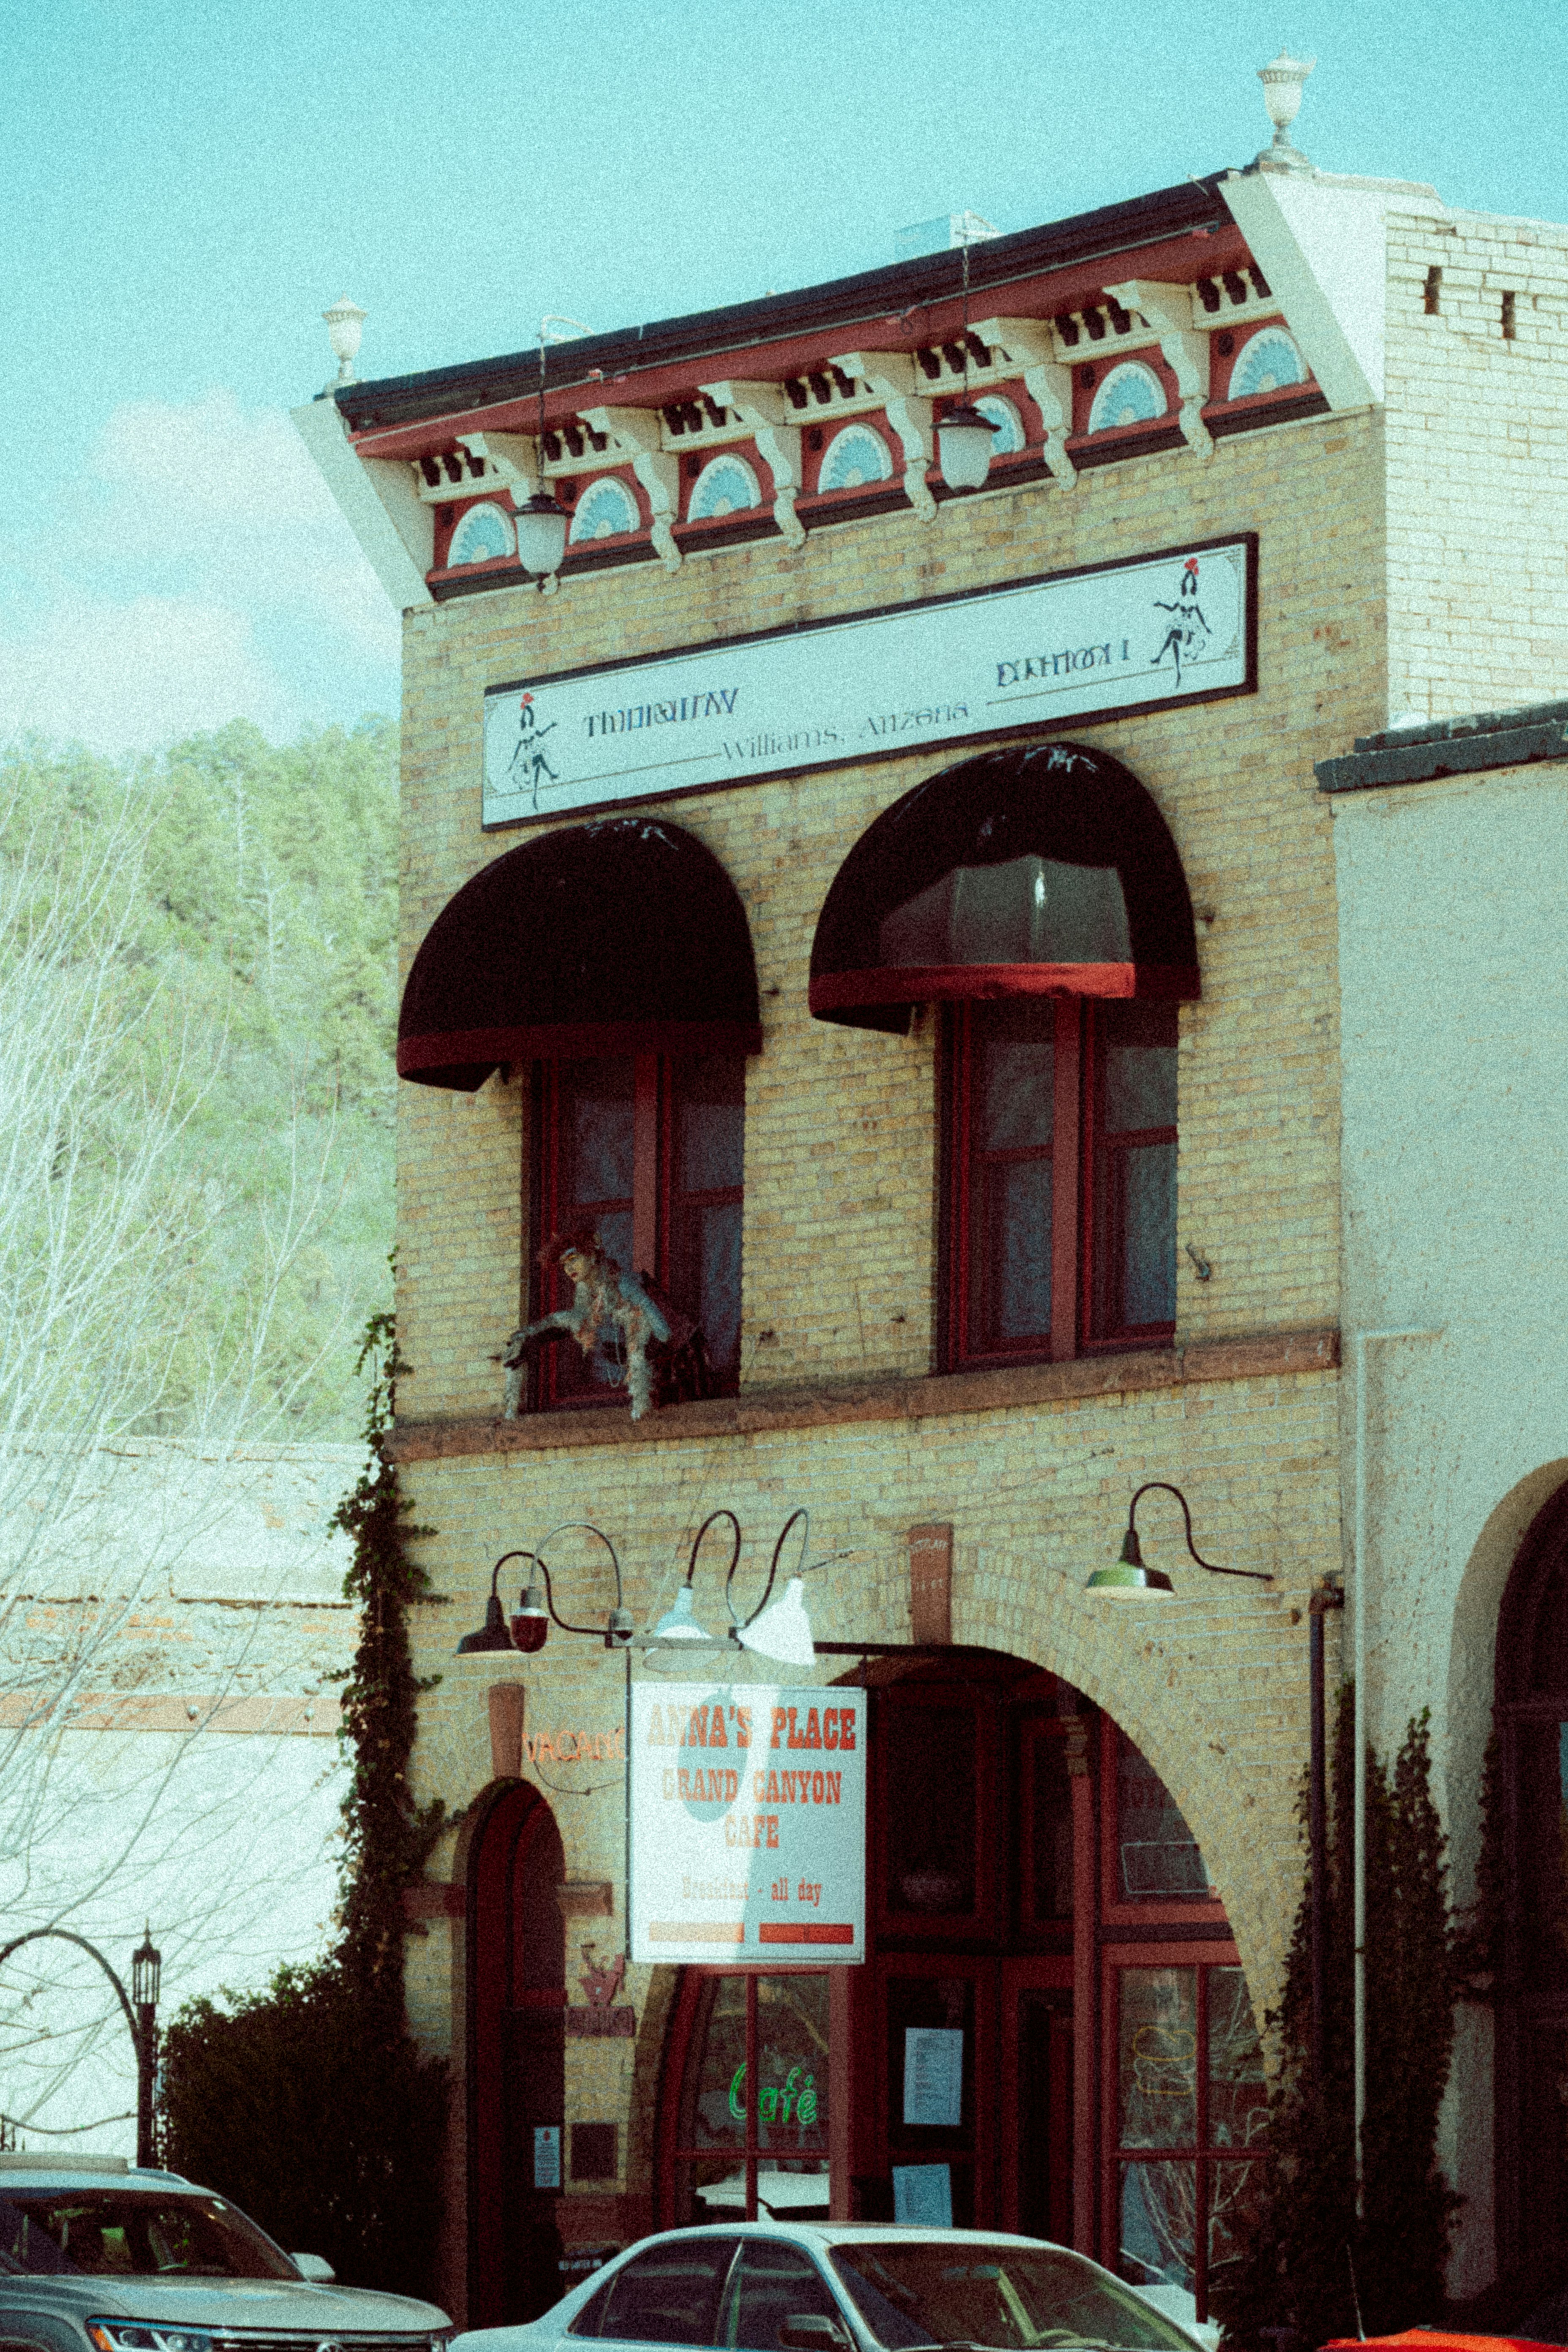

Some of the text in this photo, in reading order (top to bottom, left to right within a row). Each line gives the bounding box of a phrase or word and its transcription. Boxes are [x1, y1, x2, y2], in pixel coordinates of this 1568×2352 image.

[522, 1727, 625, 1762] VACANC
[648, 1705, 855, 1750] ANNA'S PLACE
[662, 1768, 842, 1804] GRAND CANYON
[725, 1815, 779, 1848] CAFE
[771, 1877, 789, 1901] all
[798, 1877, 822, 1907] day
